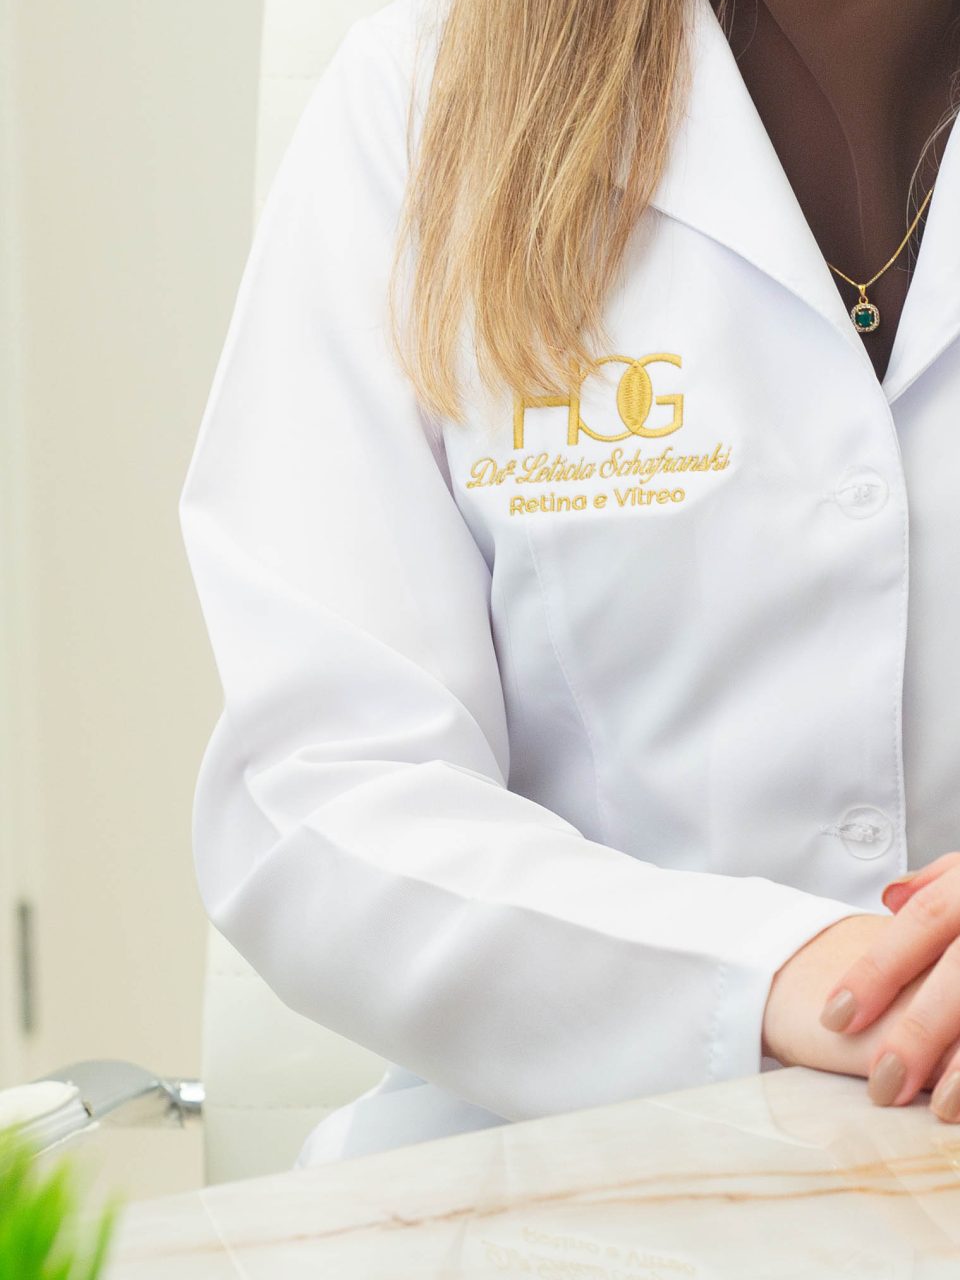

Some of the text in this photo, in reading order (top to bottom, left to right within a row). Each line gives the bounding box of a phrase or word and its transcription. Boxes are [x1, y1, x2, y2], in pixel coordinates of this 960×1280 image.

[513, 352, 684, 450] HOG
[598, 441, 733, 485] Schafranski
[509, 493, 588, 516] Retina
[592, 493, 608, 508] e
